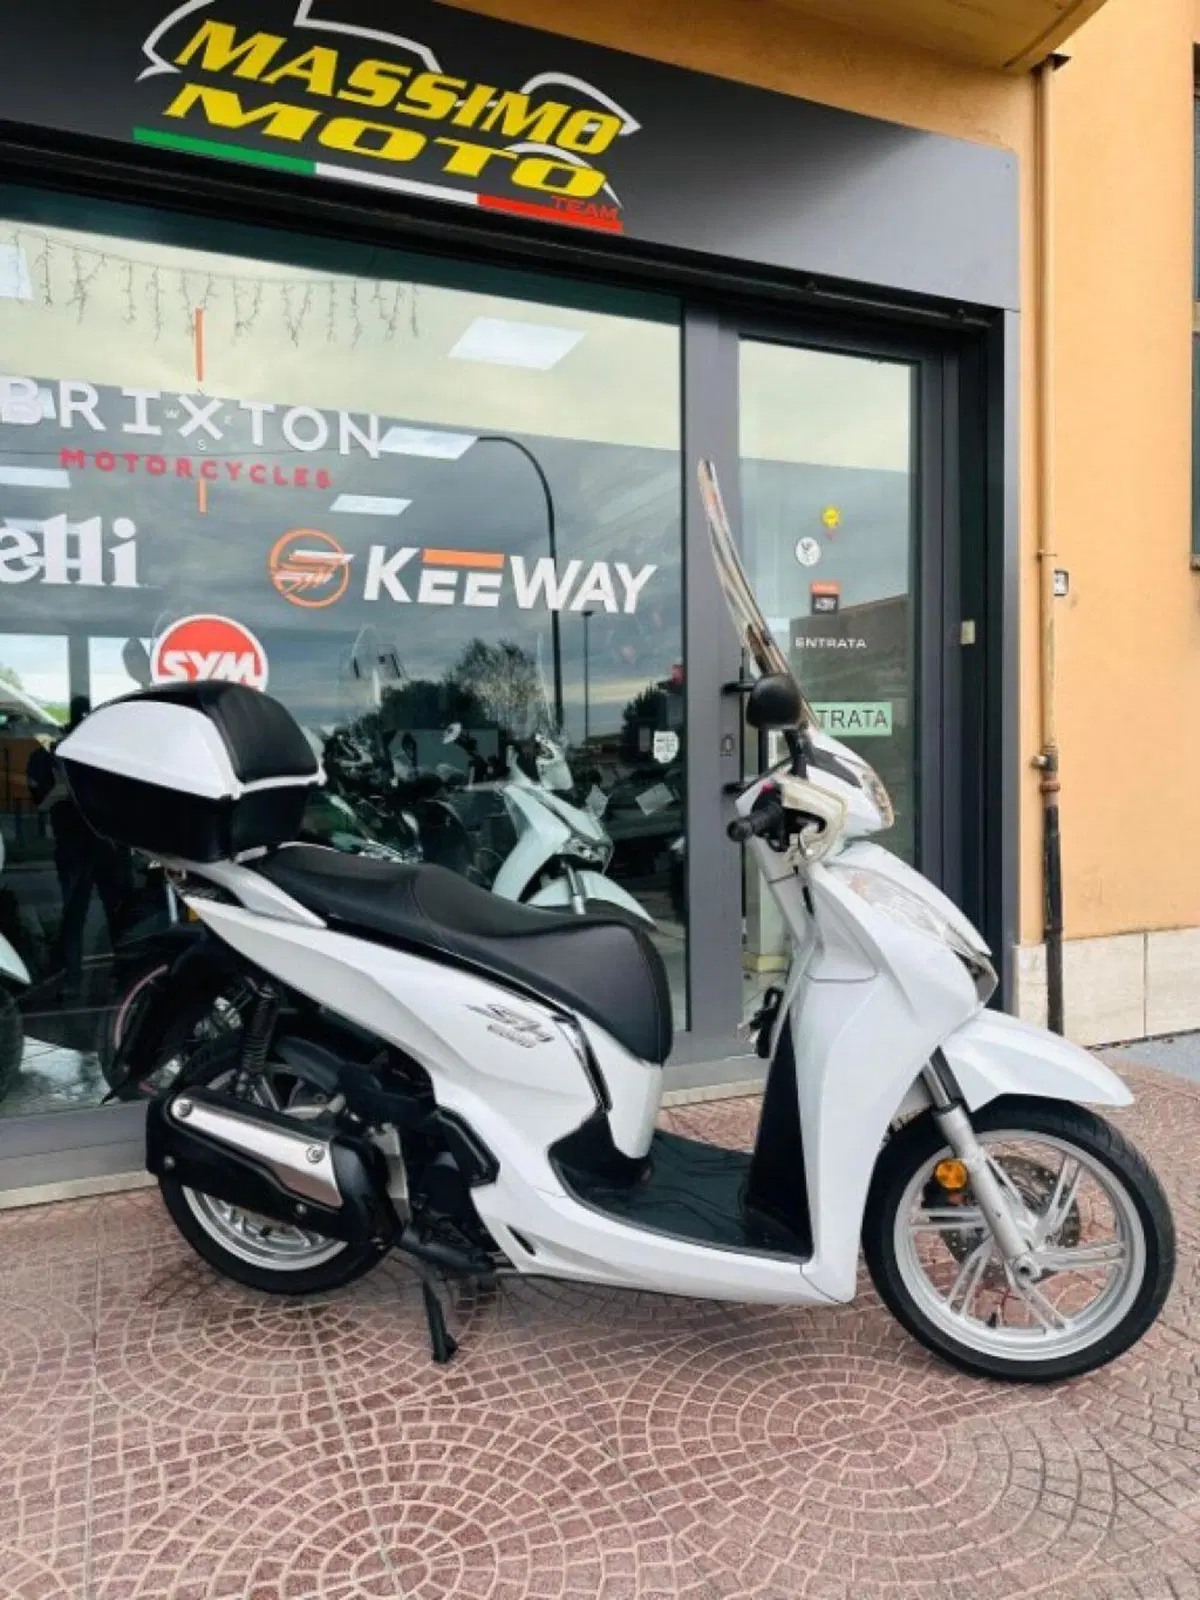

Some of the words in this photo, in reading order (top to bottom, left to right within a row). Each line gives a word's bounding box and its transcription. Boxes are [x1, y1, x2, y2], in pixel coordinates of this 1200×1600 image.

[175, 19, 624, 155] MASSIMO
[163, 82, 607, 198] MOTO
[551, 195, 619, 221] TEAM
[0, 375, 380, 459] BRIXTON
[59, 448, 333, 489] MOTORCYCLES
[363, 545, 658, 614] KEEWAY
[795, 637, 867, 649] ENTRATA
[159, 649, 262, 686] SYM
[816, 709, 889, 729] TRATA
